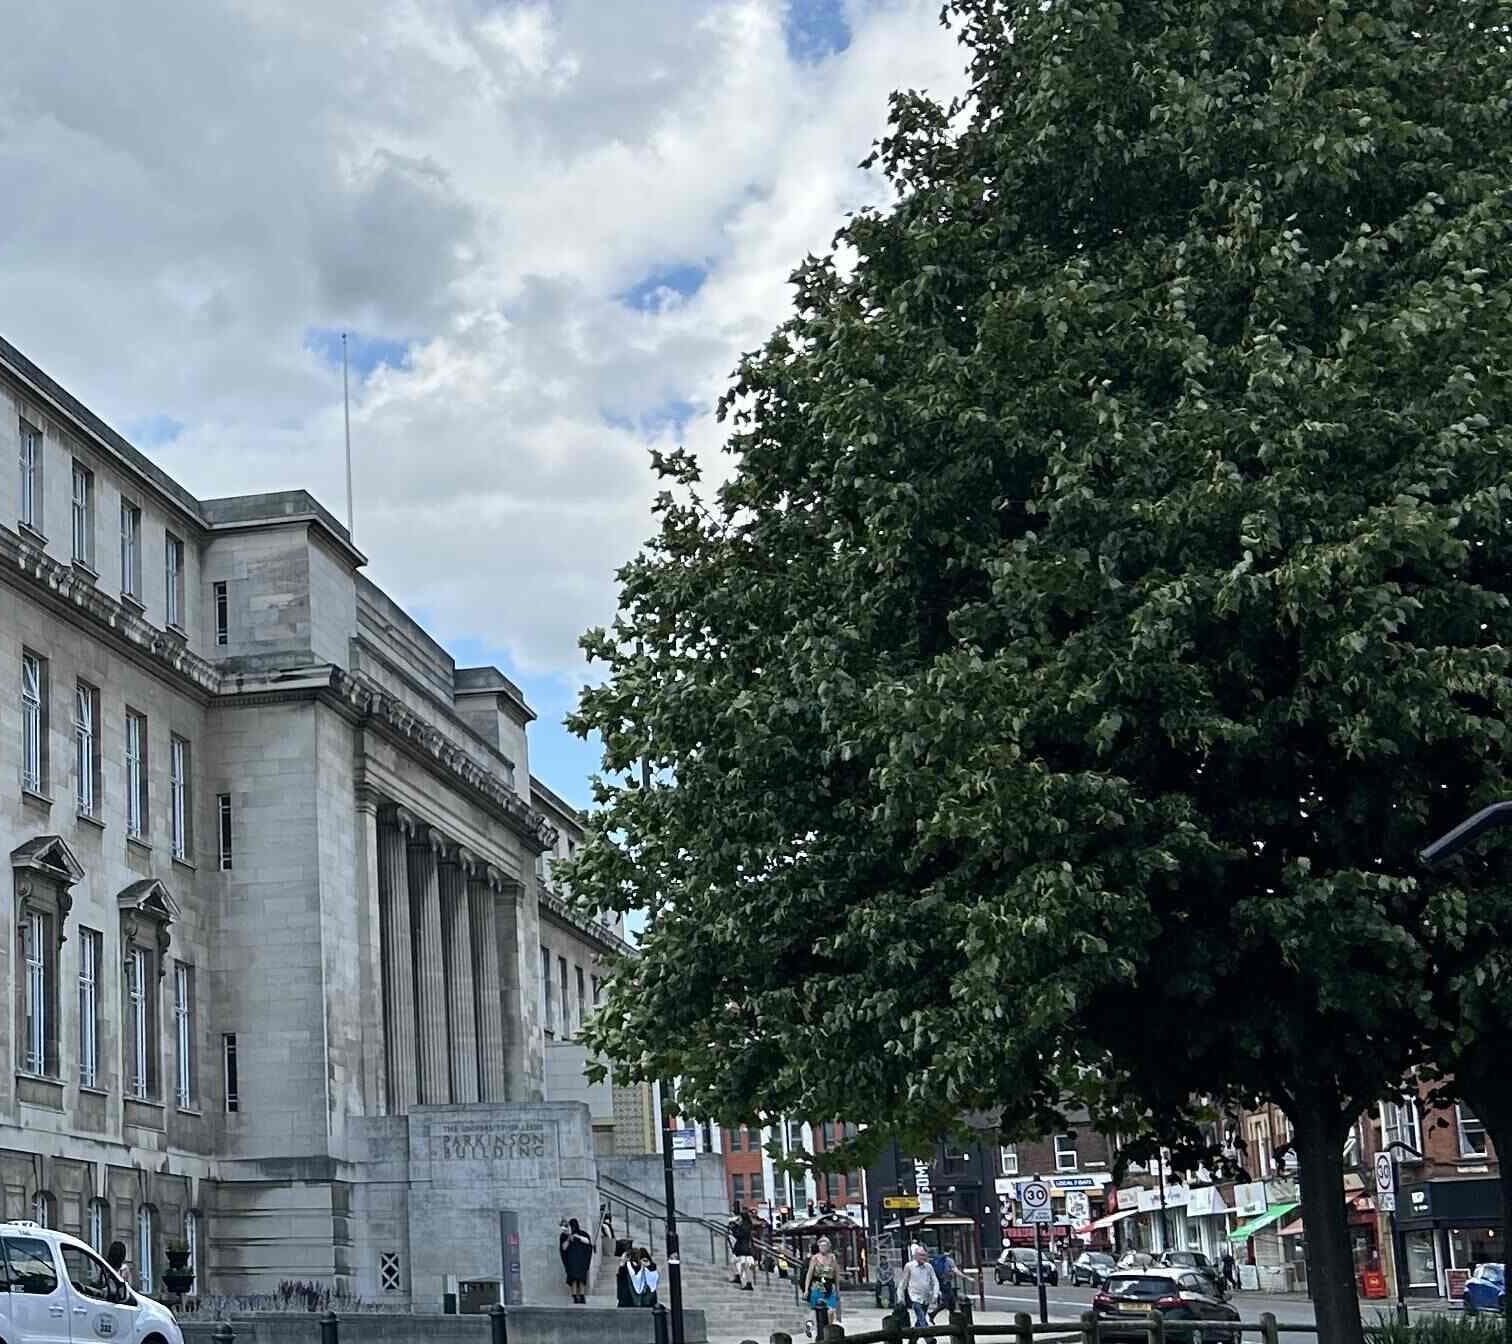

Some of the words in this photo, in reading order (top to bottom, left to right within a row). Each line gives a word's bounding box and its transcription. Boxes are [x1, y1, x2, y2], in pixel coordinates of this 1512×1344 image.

[443, 1133, 544, 1146] PARKINSON
[443, 1145, 544, 1160] BUILDING
[1376, 1164, 1390, 1178] 30
[1027, 1190, 1045, 1201] 30
